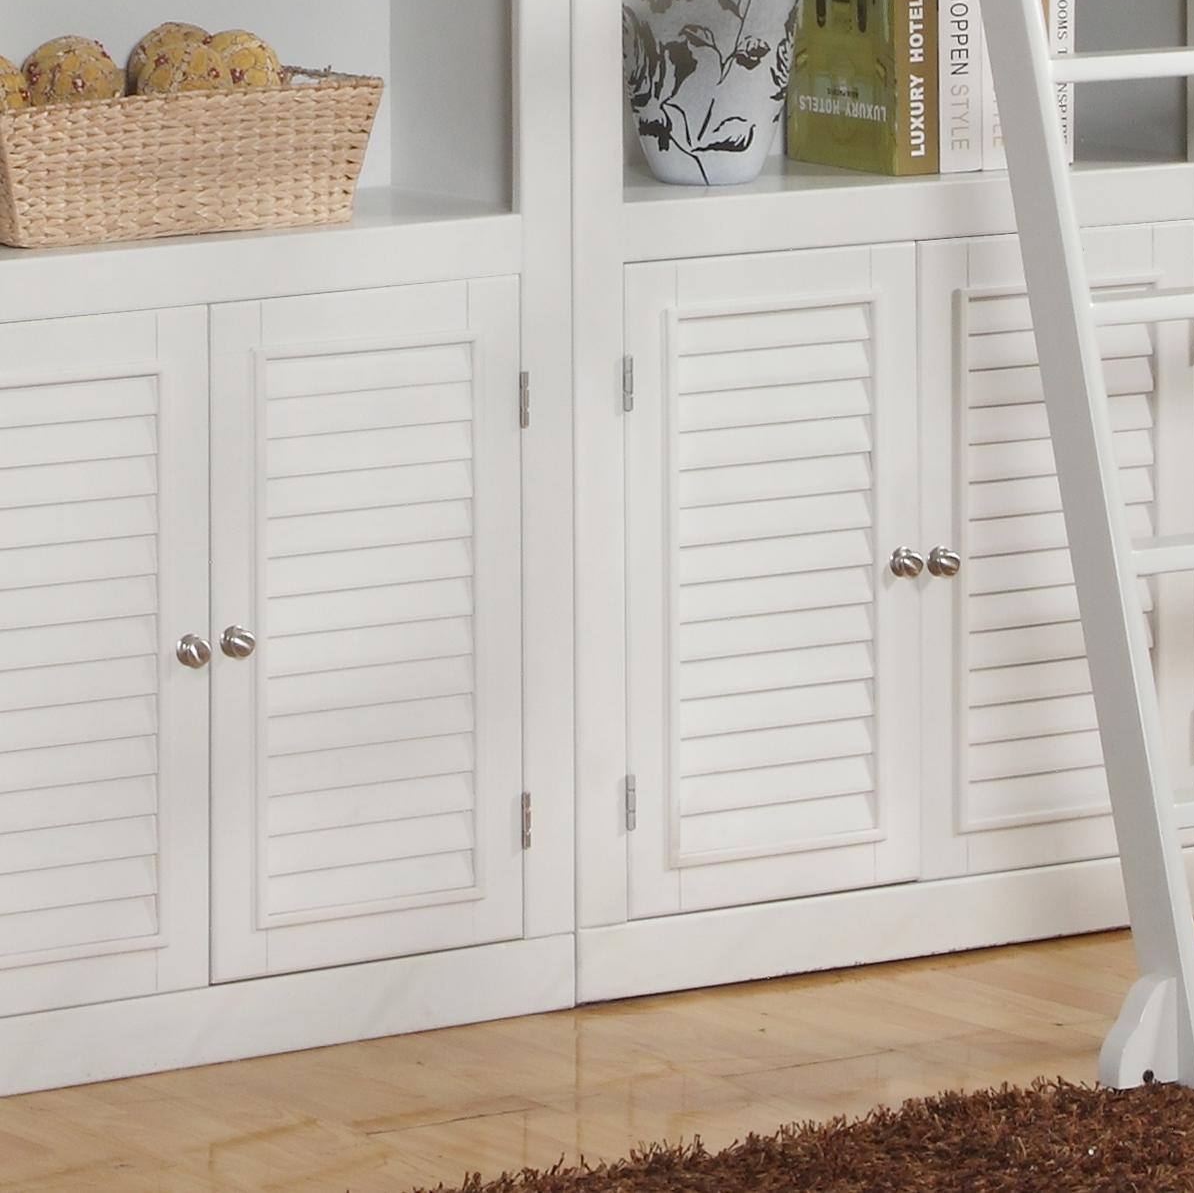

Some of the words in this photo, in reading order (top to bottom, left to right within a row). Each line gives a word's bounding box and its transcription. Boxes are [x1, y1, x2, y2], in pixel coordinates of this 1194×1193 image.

[799, 95, 840, 115] HOTELS
[845, 102, 887, 122] LUXURY
[909, 74, 925, 157] LUXURY
[950, 84, 970, 150] STYLE
